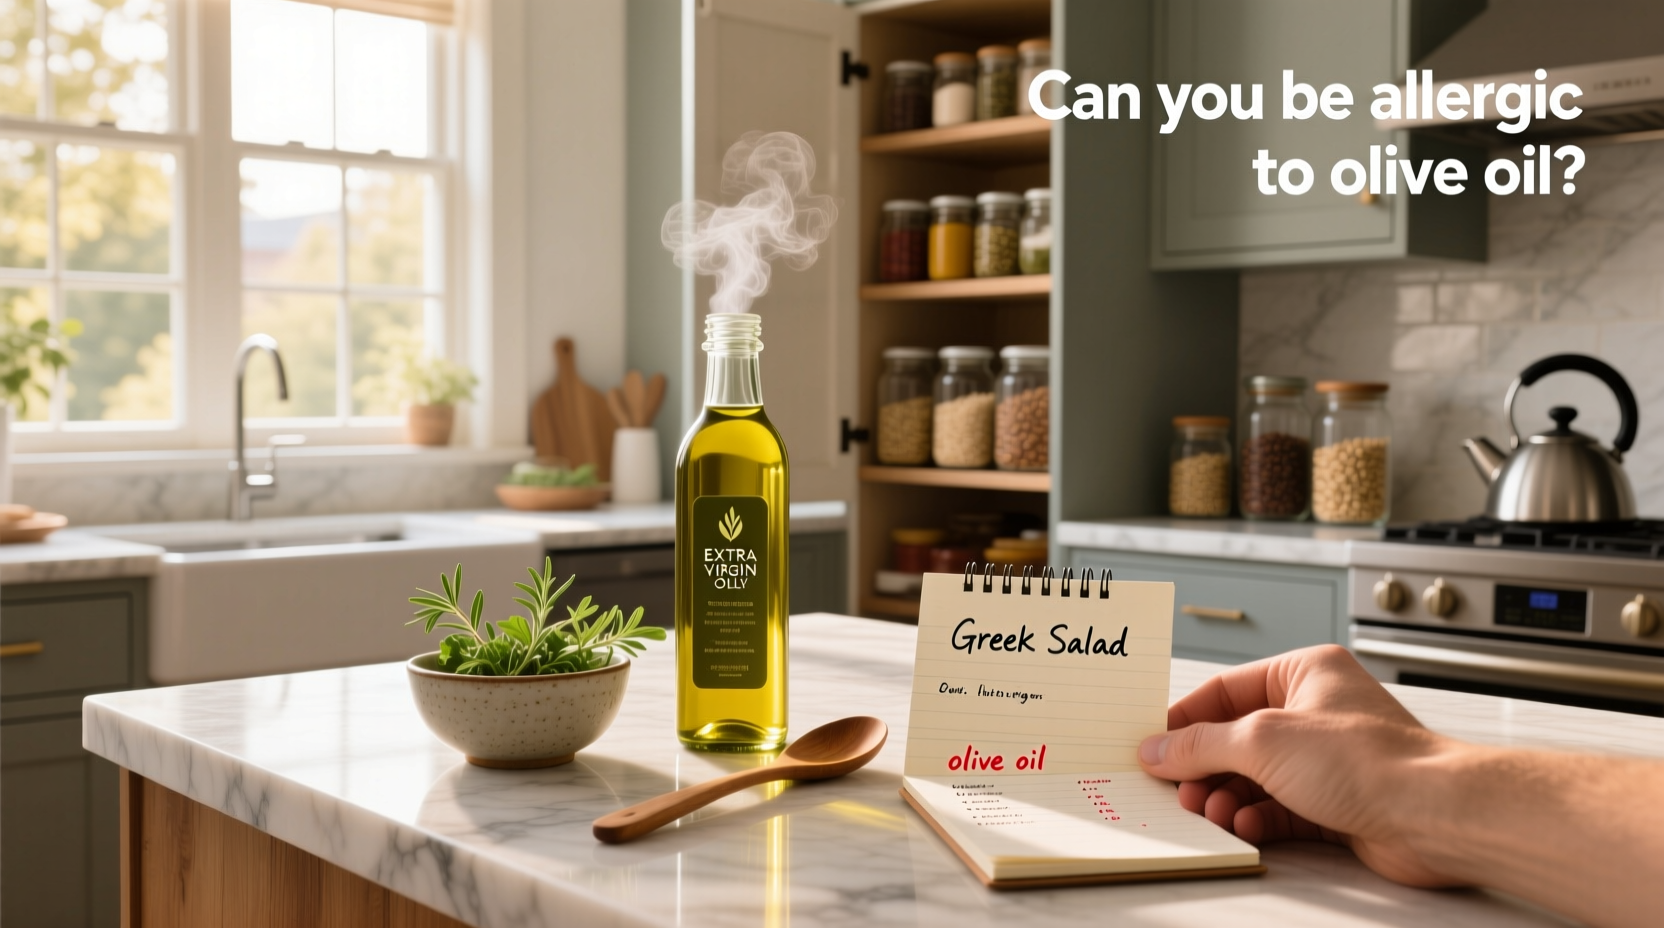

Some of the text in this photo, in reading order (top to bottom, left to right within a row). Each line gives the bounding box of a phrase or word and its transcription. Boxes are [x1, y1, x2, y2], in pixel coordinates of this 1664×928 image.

[704, 548, 757, 562] EXTRA
[704, 563, 757, 577] VIRGIN
[951, 617, 1129, 657] Greek Salad
[948, 744, 1047, 772] olive oil
